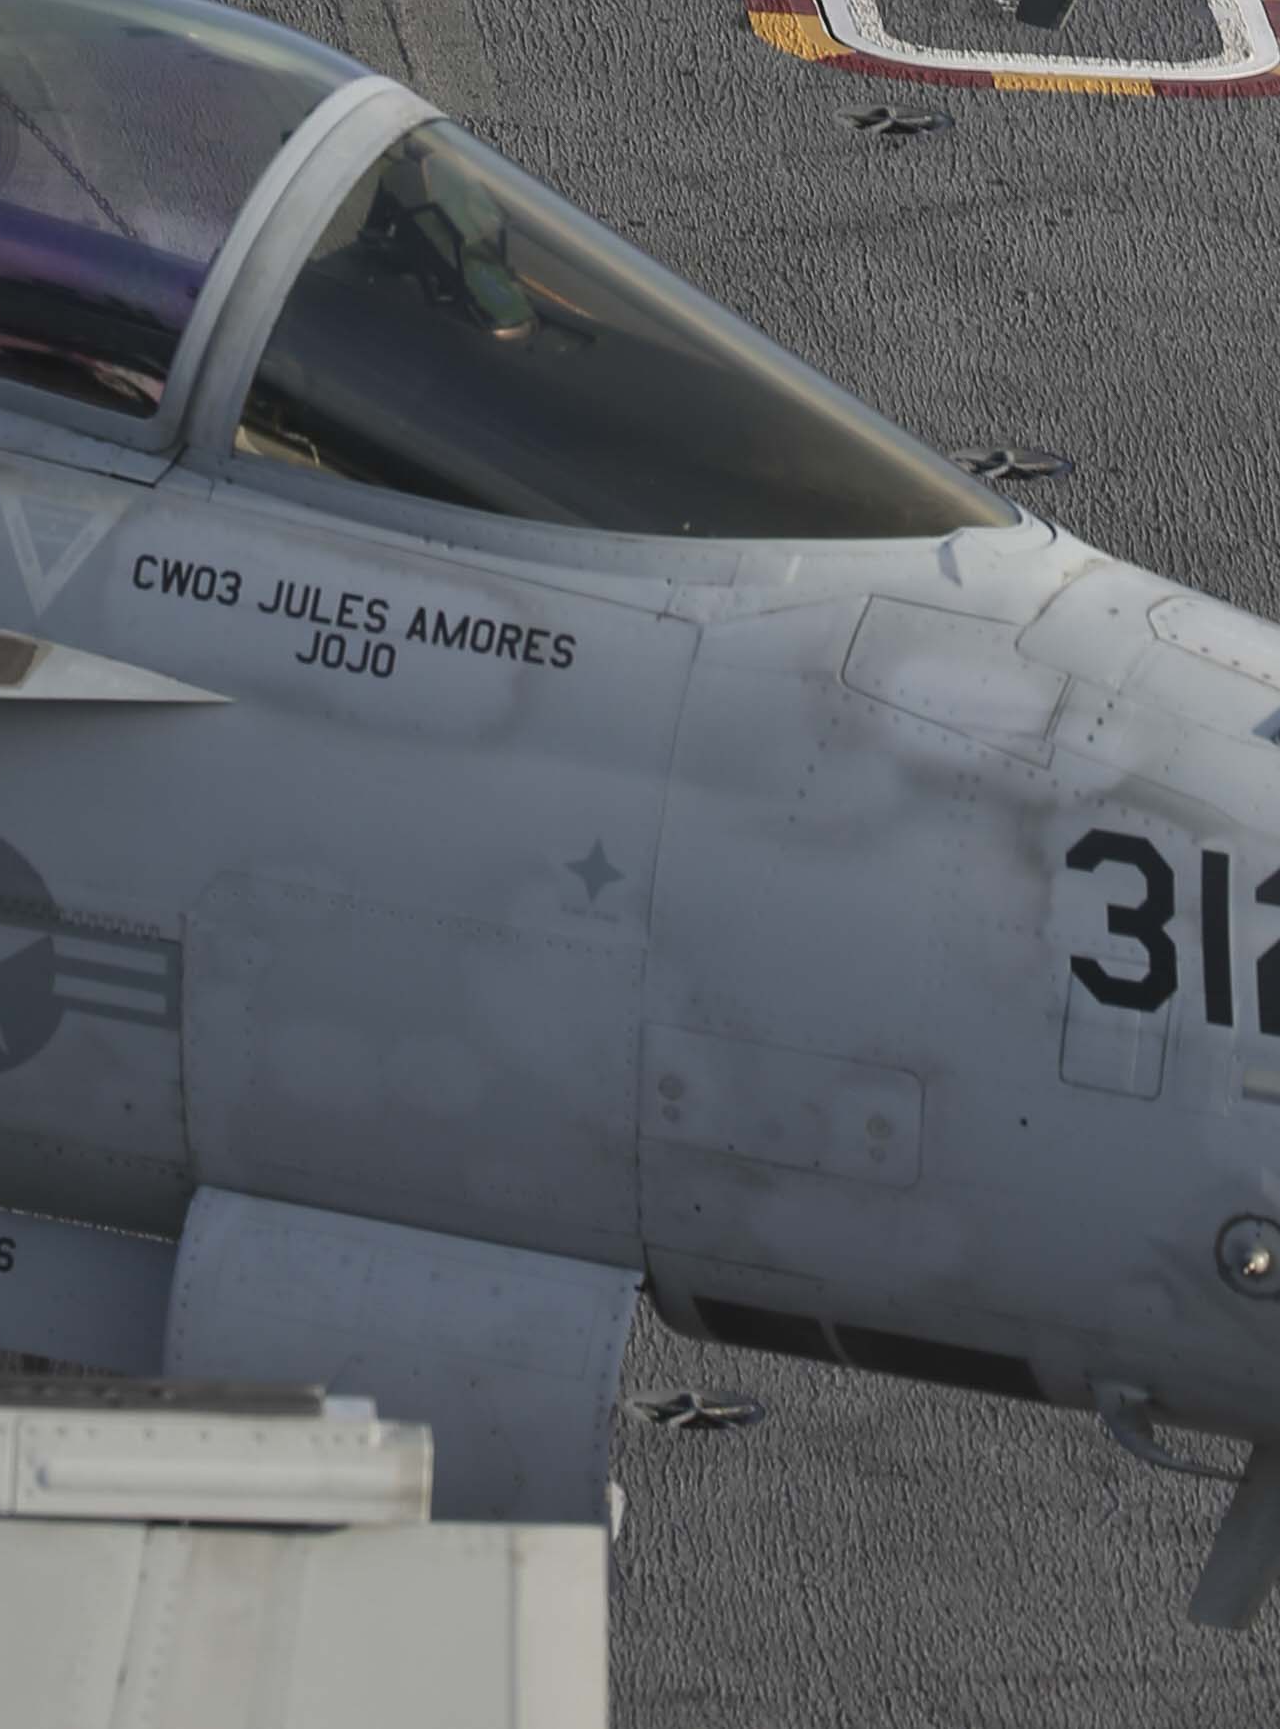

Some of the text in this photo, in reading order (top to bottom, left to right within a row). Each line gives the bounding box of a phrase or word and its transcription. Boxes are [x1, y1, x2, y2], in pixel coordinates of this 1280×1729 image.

[257, 579, 391, 635] JULES
[405, 606, 577, 670] AMORES
[295, 630, 397, 679] JOJO
